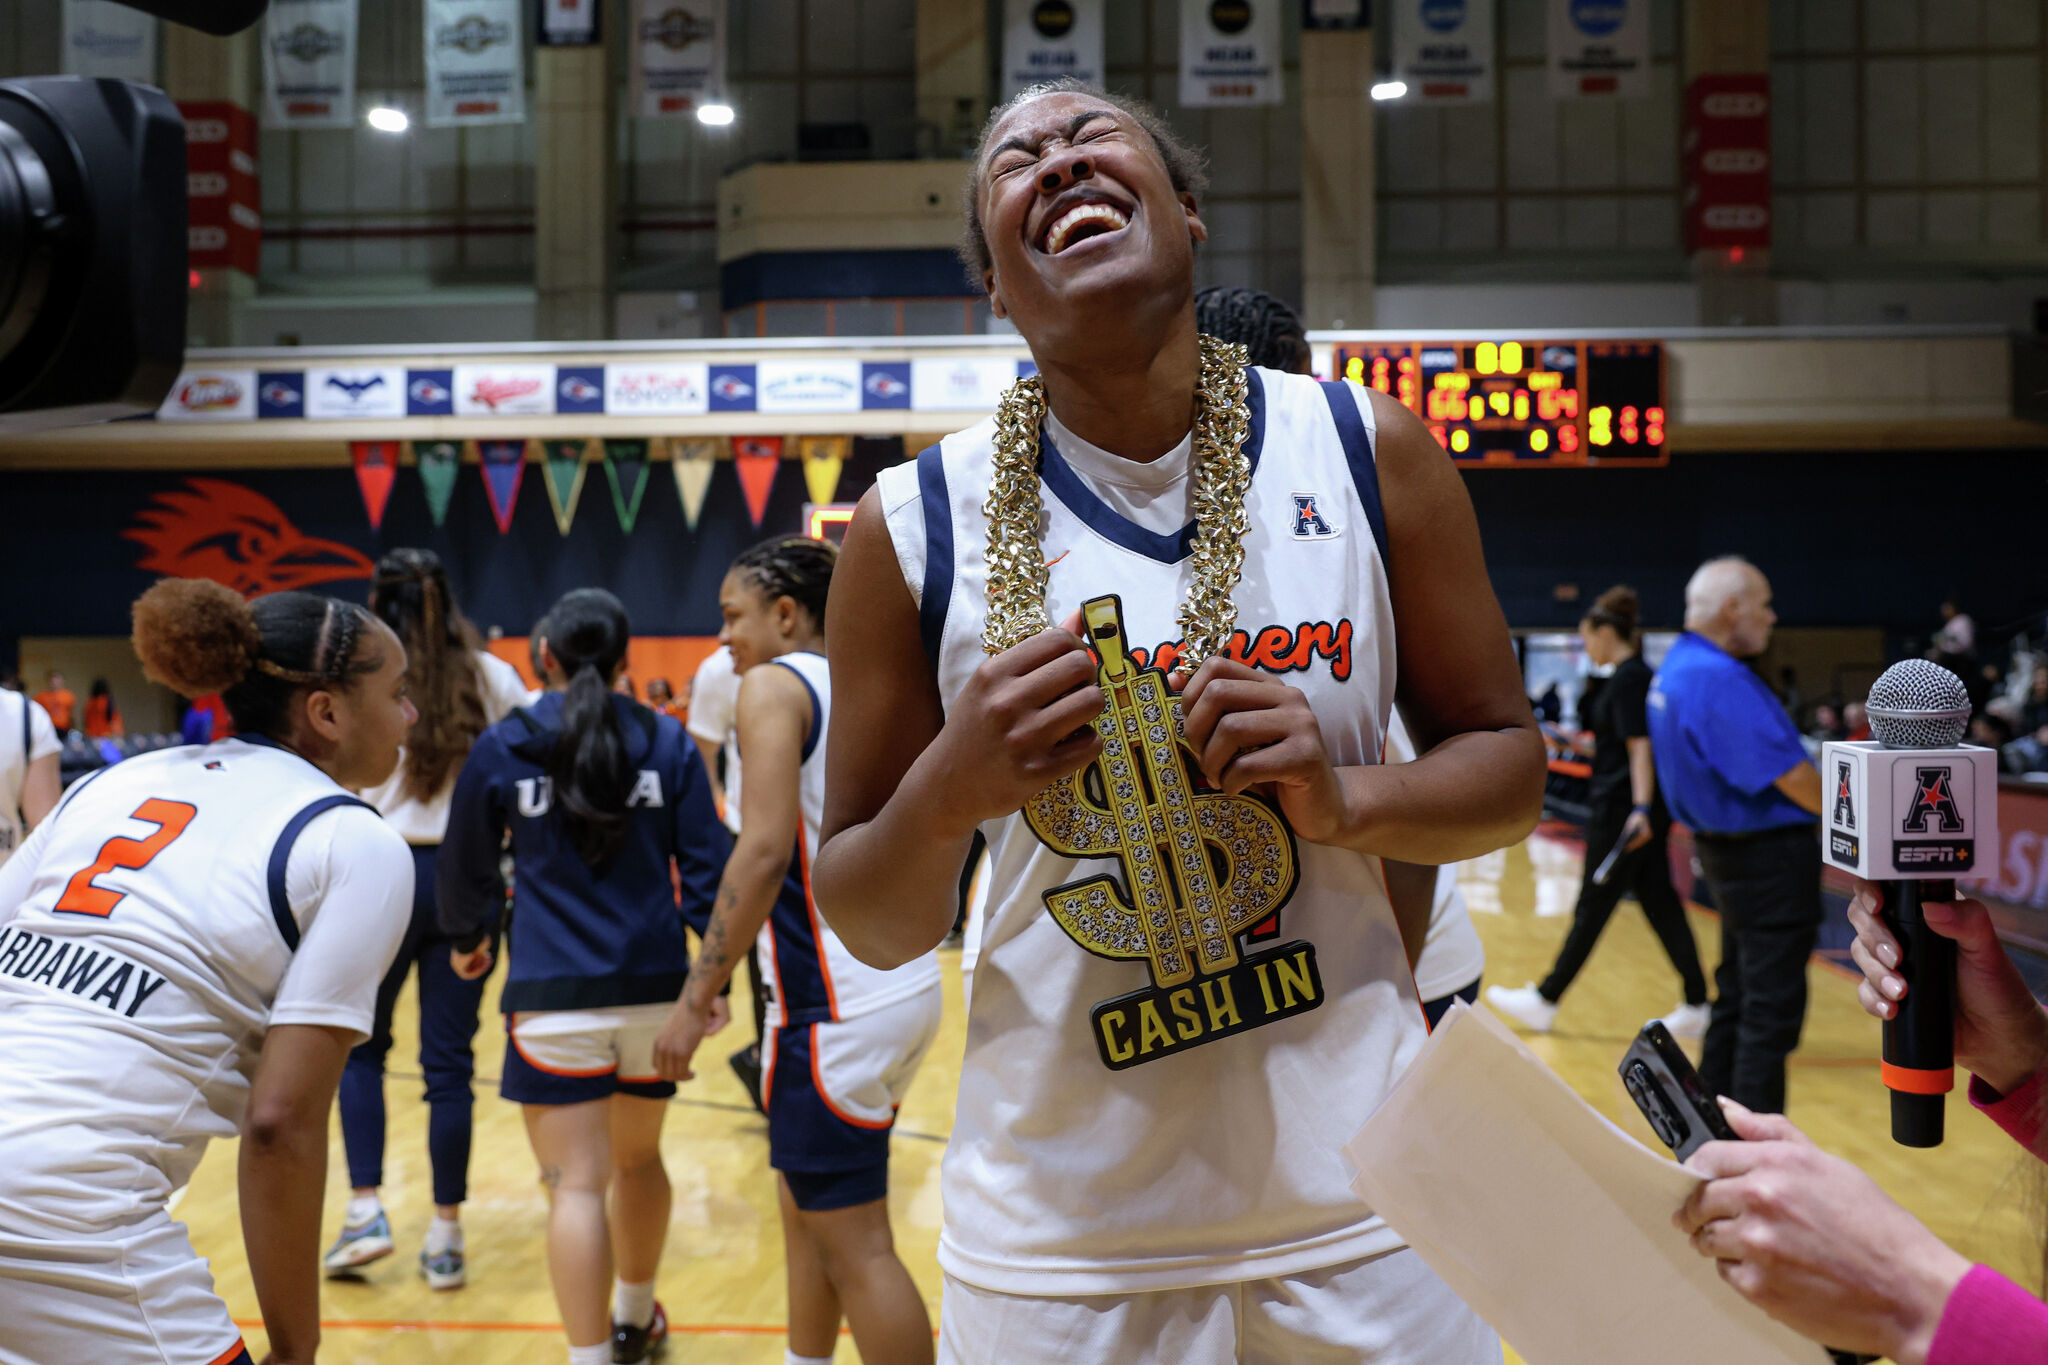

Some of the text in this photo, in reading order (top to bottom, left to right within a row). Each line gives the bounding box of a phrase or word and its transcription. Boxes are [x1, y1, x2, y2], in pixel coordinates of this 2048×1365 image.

[1903, 766, 1964, 833] A
[52, 797, 198, 919] 2
[1898, 847, 1969, 863] ESPN+
[1100, 951, 1316, 1063] CASH IN
